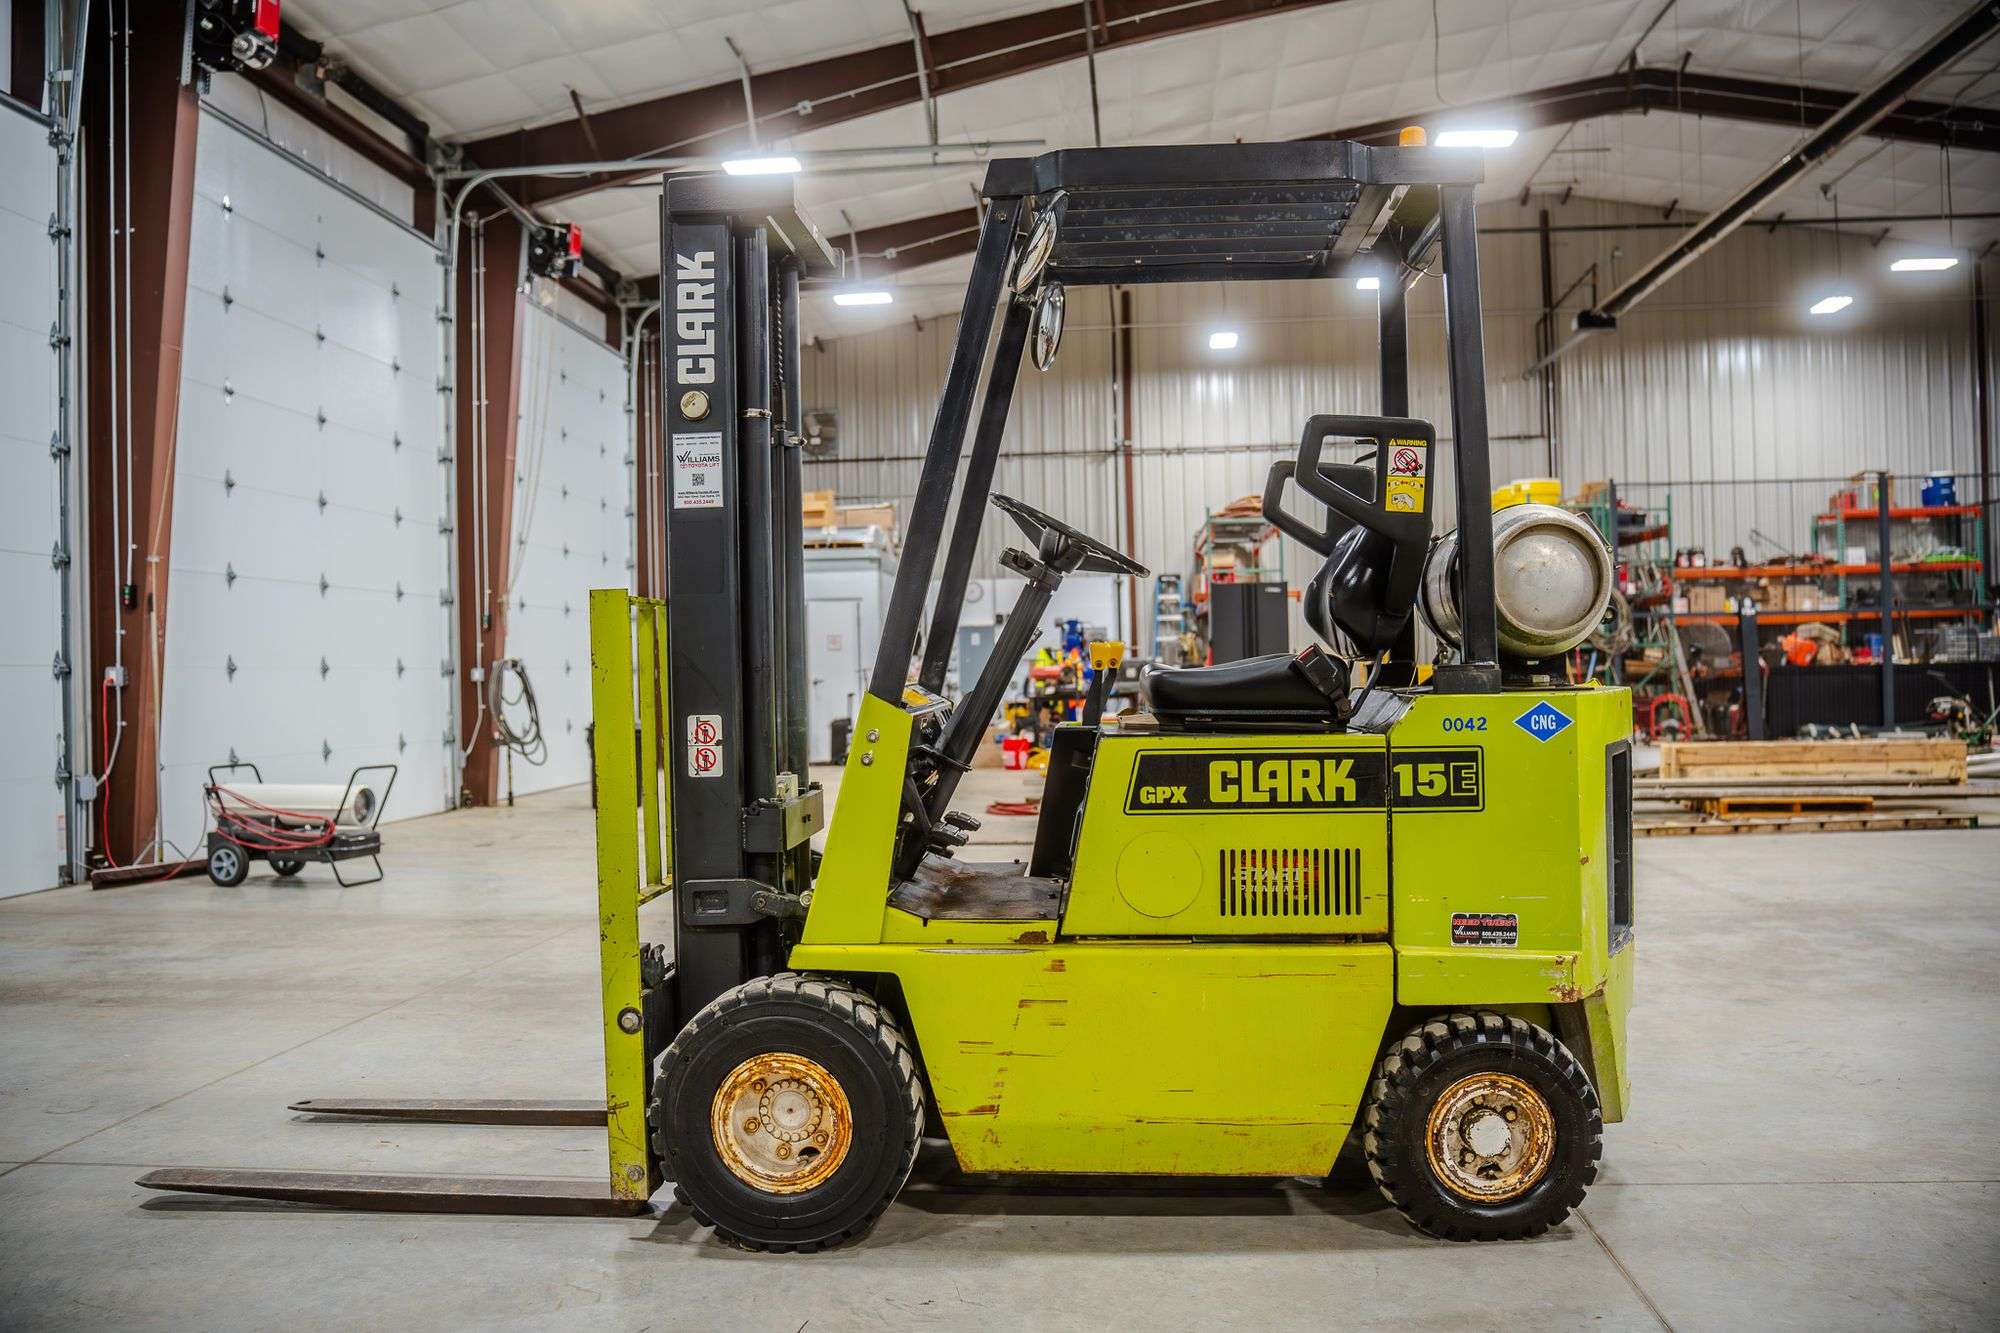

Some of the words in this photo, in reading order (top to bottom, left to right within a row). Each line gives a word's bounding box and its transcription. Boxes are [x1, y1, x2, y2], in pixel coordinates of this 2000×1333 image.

[677, 251, 715, 384] CLARK
[676, 450, 720, 463] WILLIAMS
[1442, 716, 1488, 732] 0042
[1530, 714, 1556, 730] CNG
[1139, 786, 1187, 804] GPX
[1209, 758, 1356, 803] CLARK
